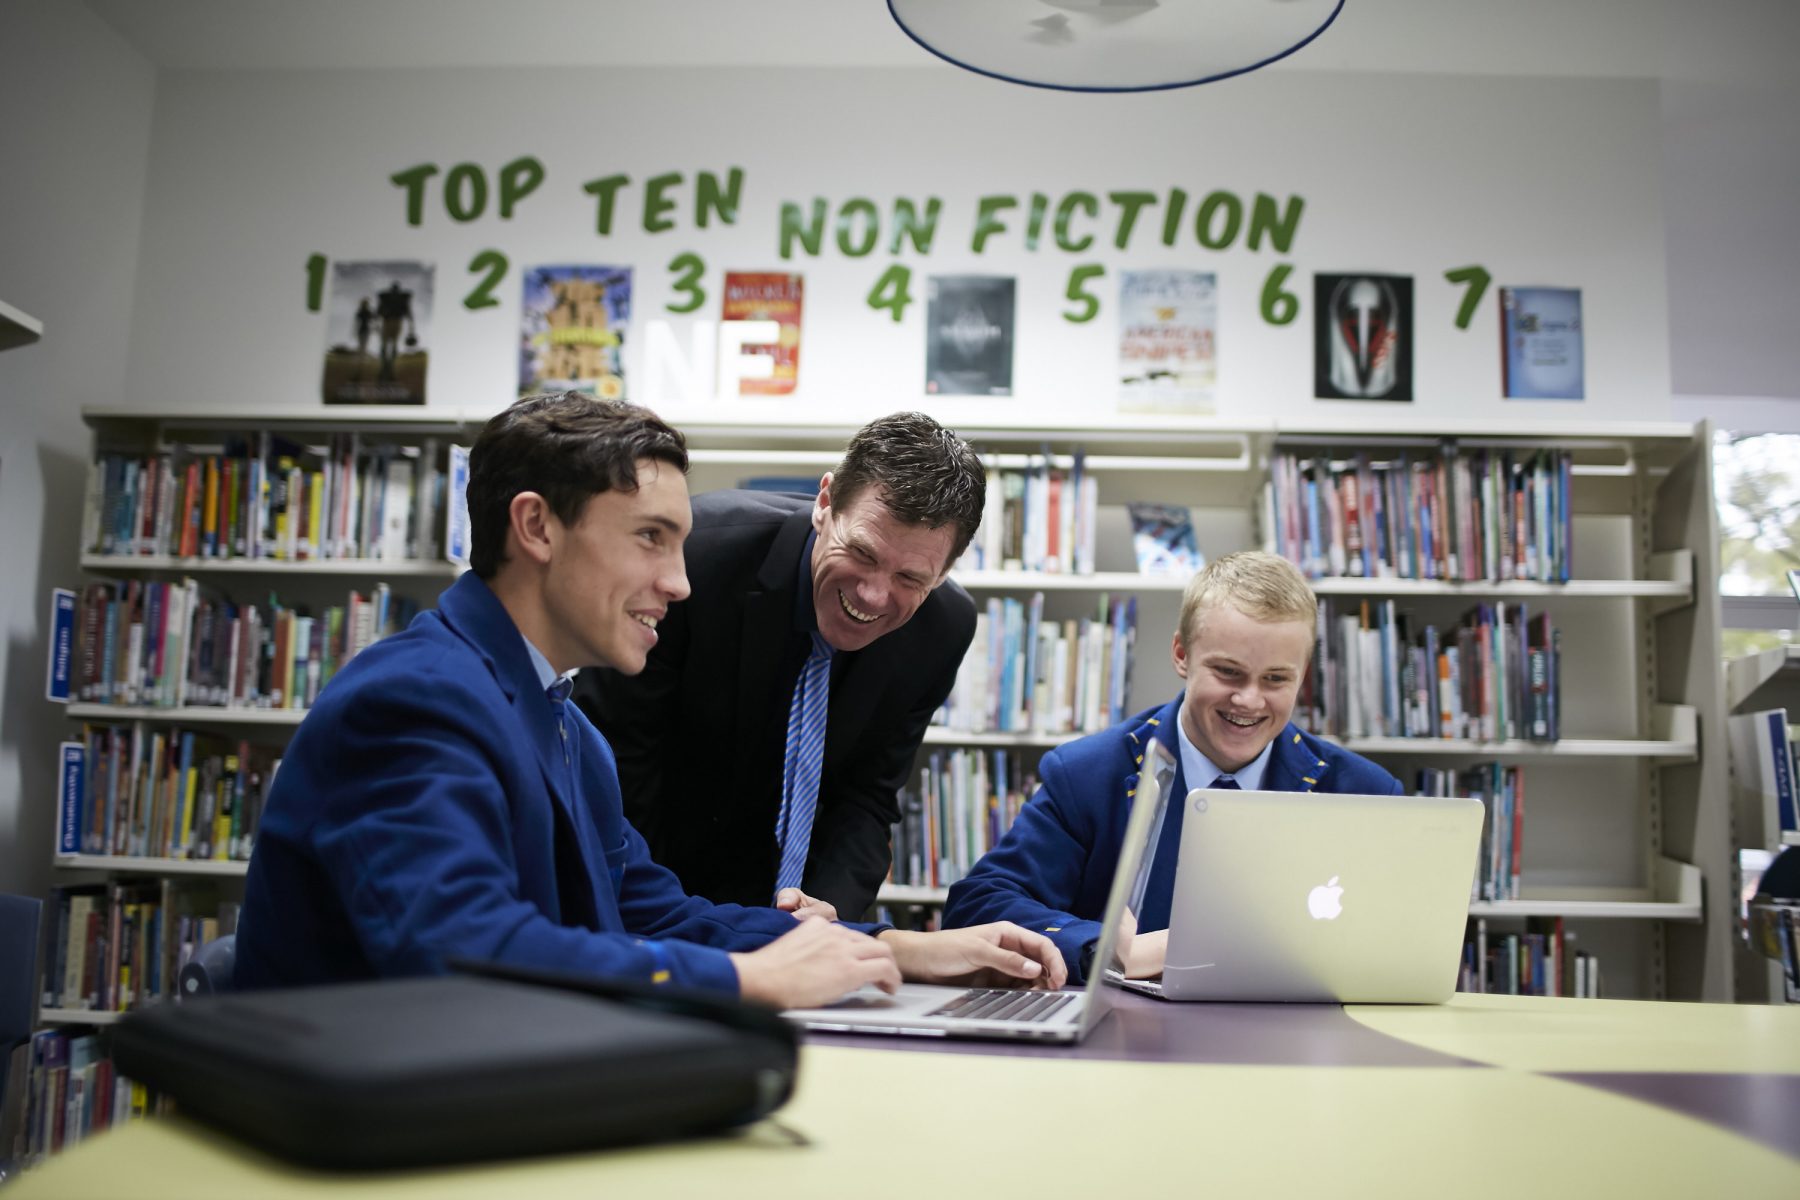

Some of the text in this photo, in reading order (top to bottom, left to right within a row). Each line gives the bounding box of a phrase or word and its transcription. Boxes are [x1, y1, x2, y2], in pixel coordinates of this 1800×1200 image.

[389, 156, 1306, 260] TOP TEN NON FICTION
[305, 252, 327, 311] 1
[463, 248, 509, 311] 2
[664, 251, 707, 314] 3
[866, 263, 914, 323] 4
[1061, 263, 1105, 325] 5
[1258, 262, 1300, 326] 6
[1444, 264, 1492, 331] 7
[55, 625, 70, 682] Religion
